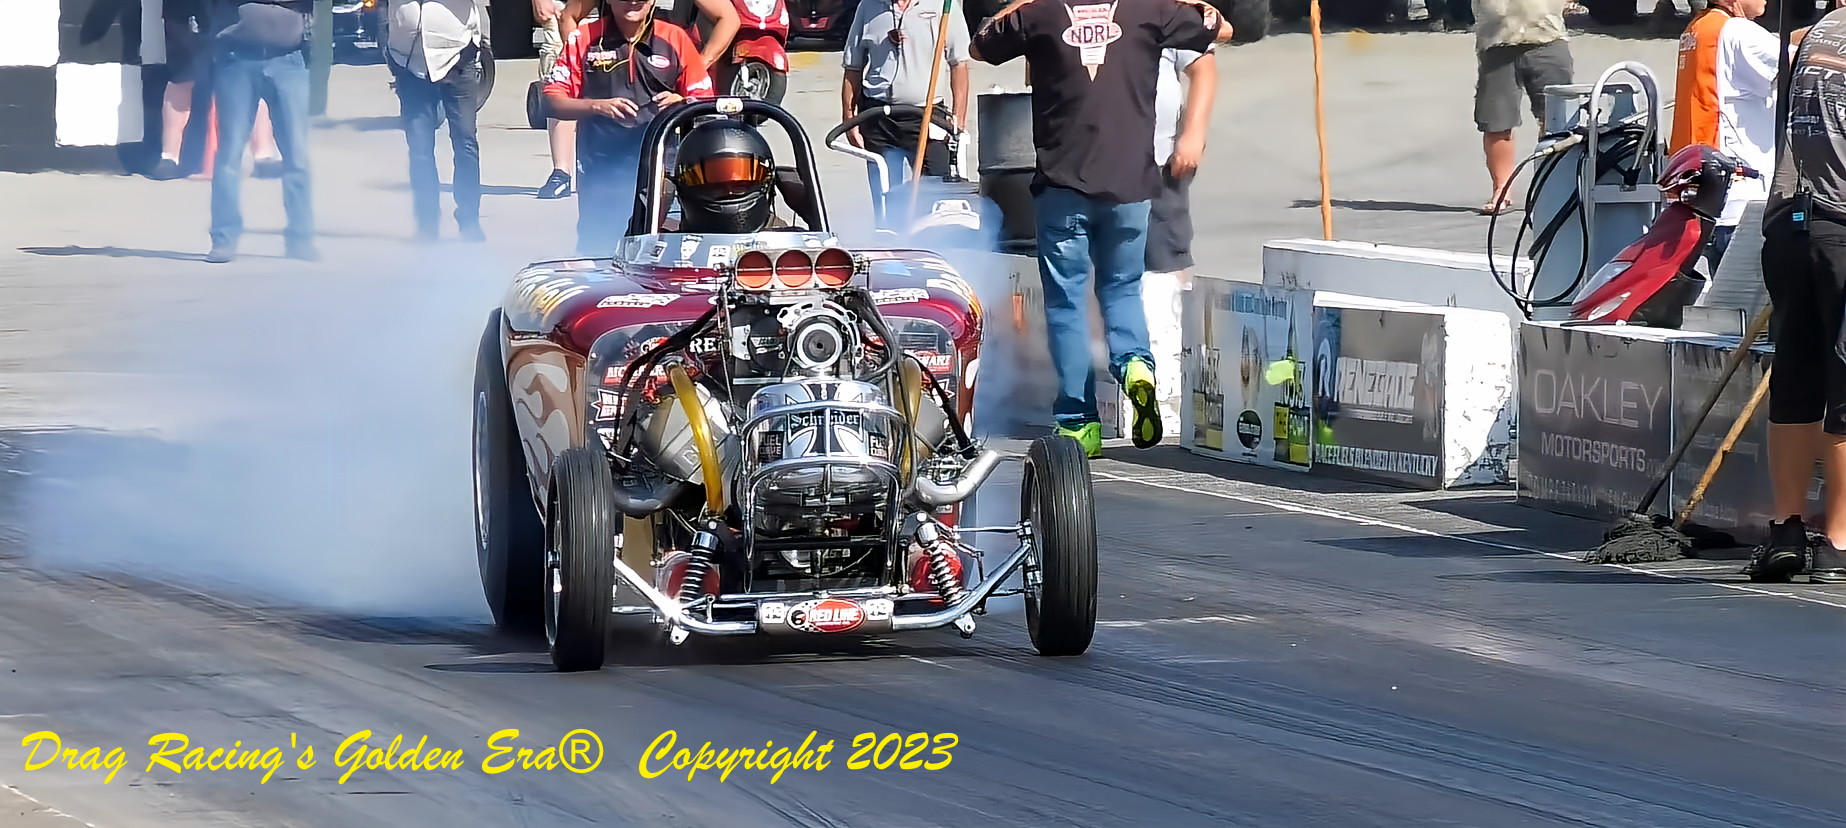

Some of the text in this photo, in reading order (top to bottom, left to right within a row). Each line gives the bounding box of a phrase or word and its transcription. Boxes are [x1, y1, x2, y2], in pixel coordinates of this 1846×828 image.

[1071, 25, 1118, 43] NDRL
[1534, 369, 1663, 429] OAKLEY
[1541, 432, 1646, 472] MOTORSPORTS
